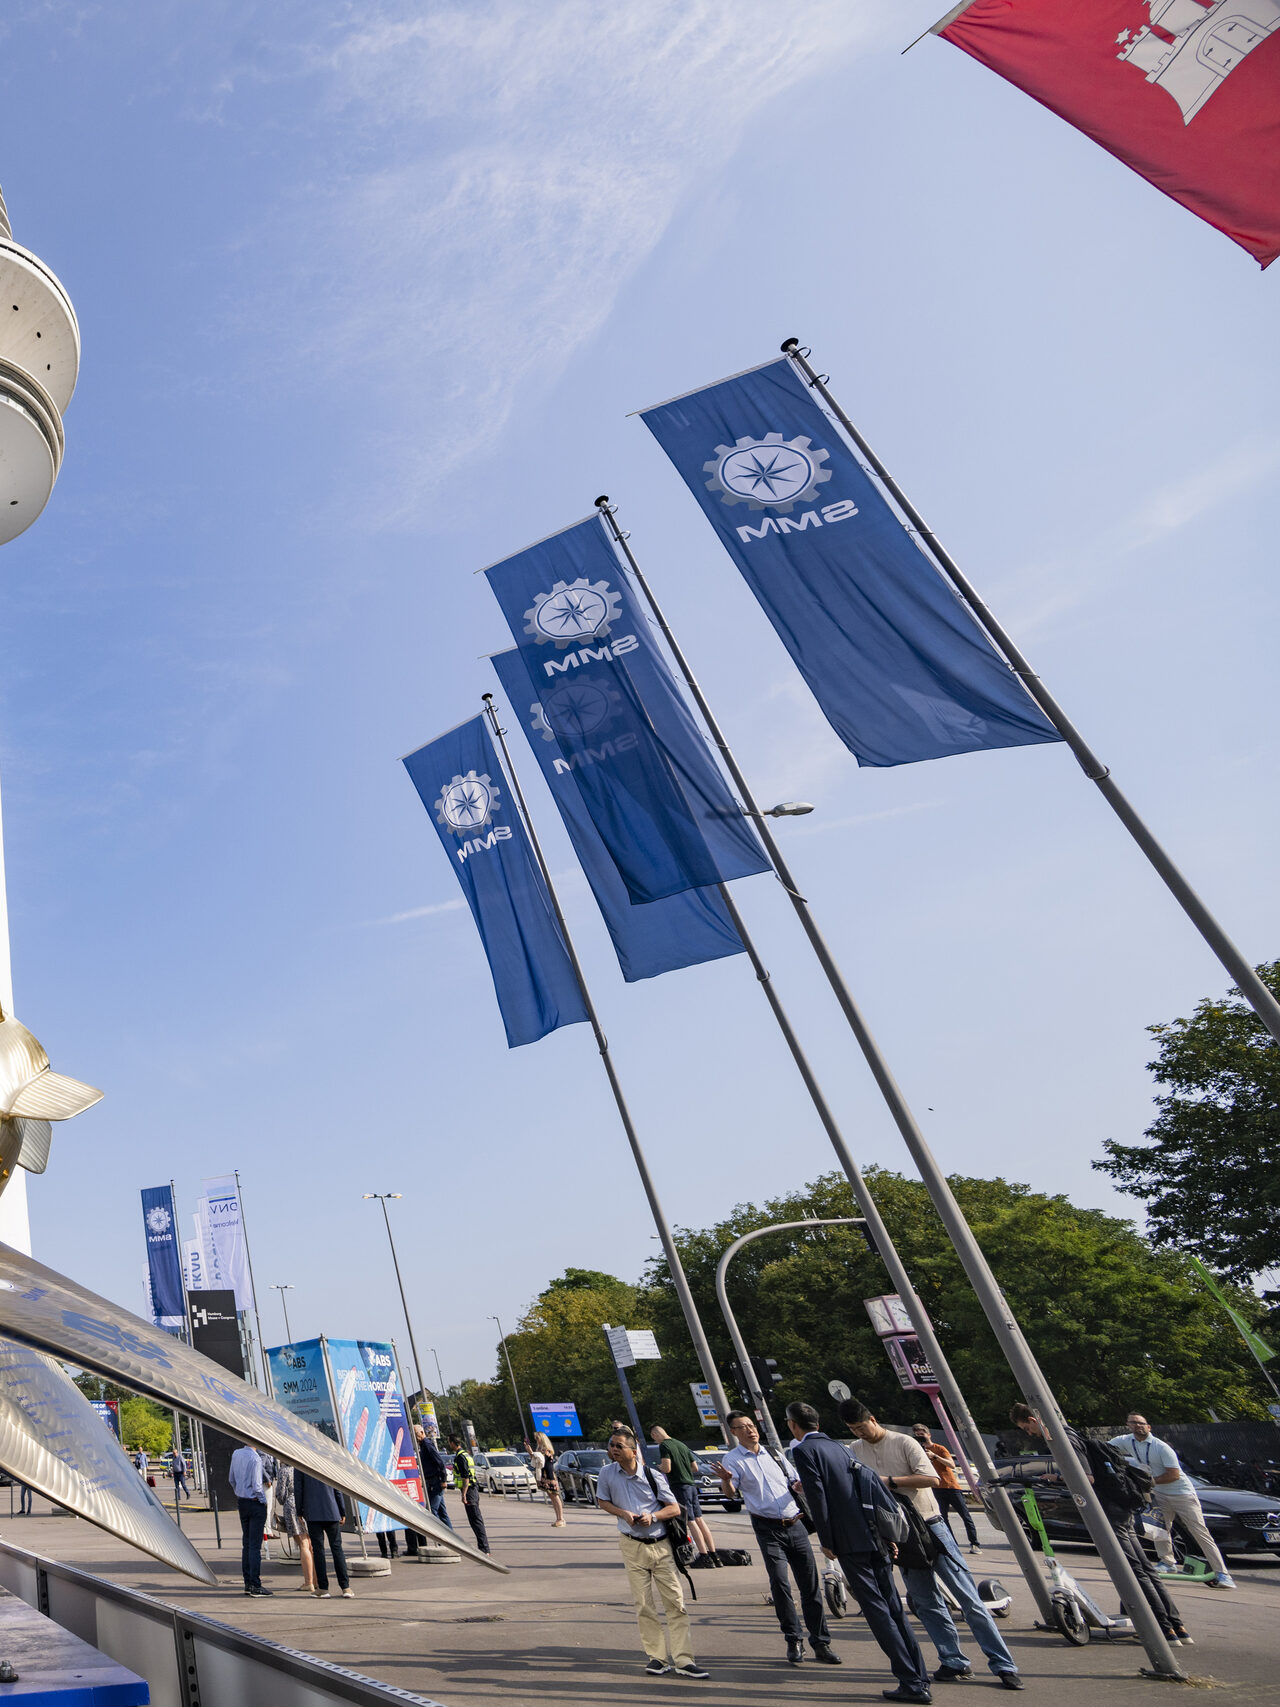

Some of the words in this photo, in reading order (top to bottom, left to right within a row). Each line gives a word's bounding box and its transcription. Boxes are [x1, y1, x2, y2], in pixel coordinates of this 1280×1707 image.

[292, 1356, 306, 1369] ABS
[374, 1354, 392, 1367] ABS
[283, 1381, 299, 1394] SMM
[300, 1378, 318, 1392] 2024
